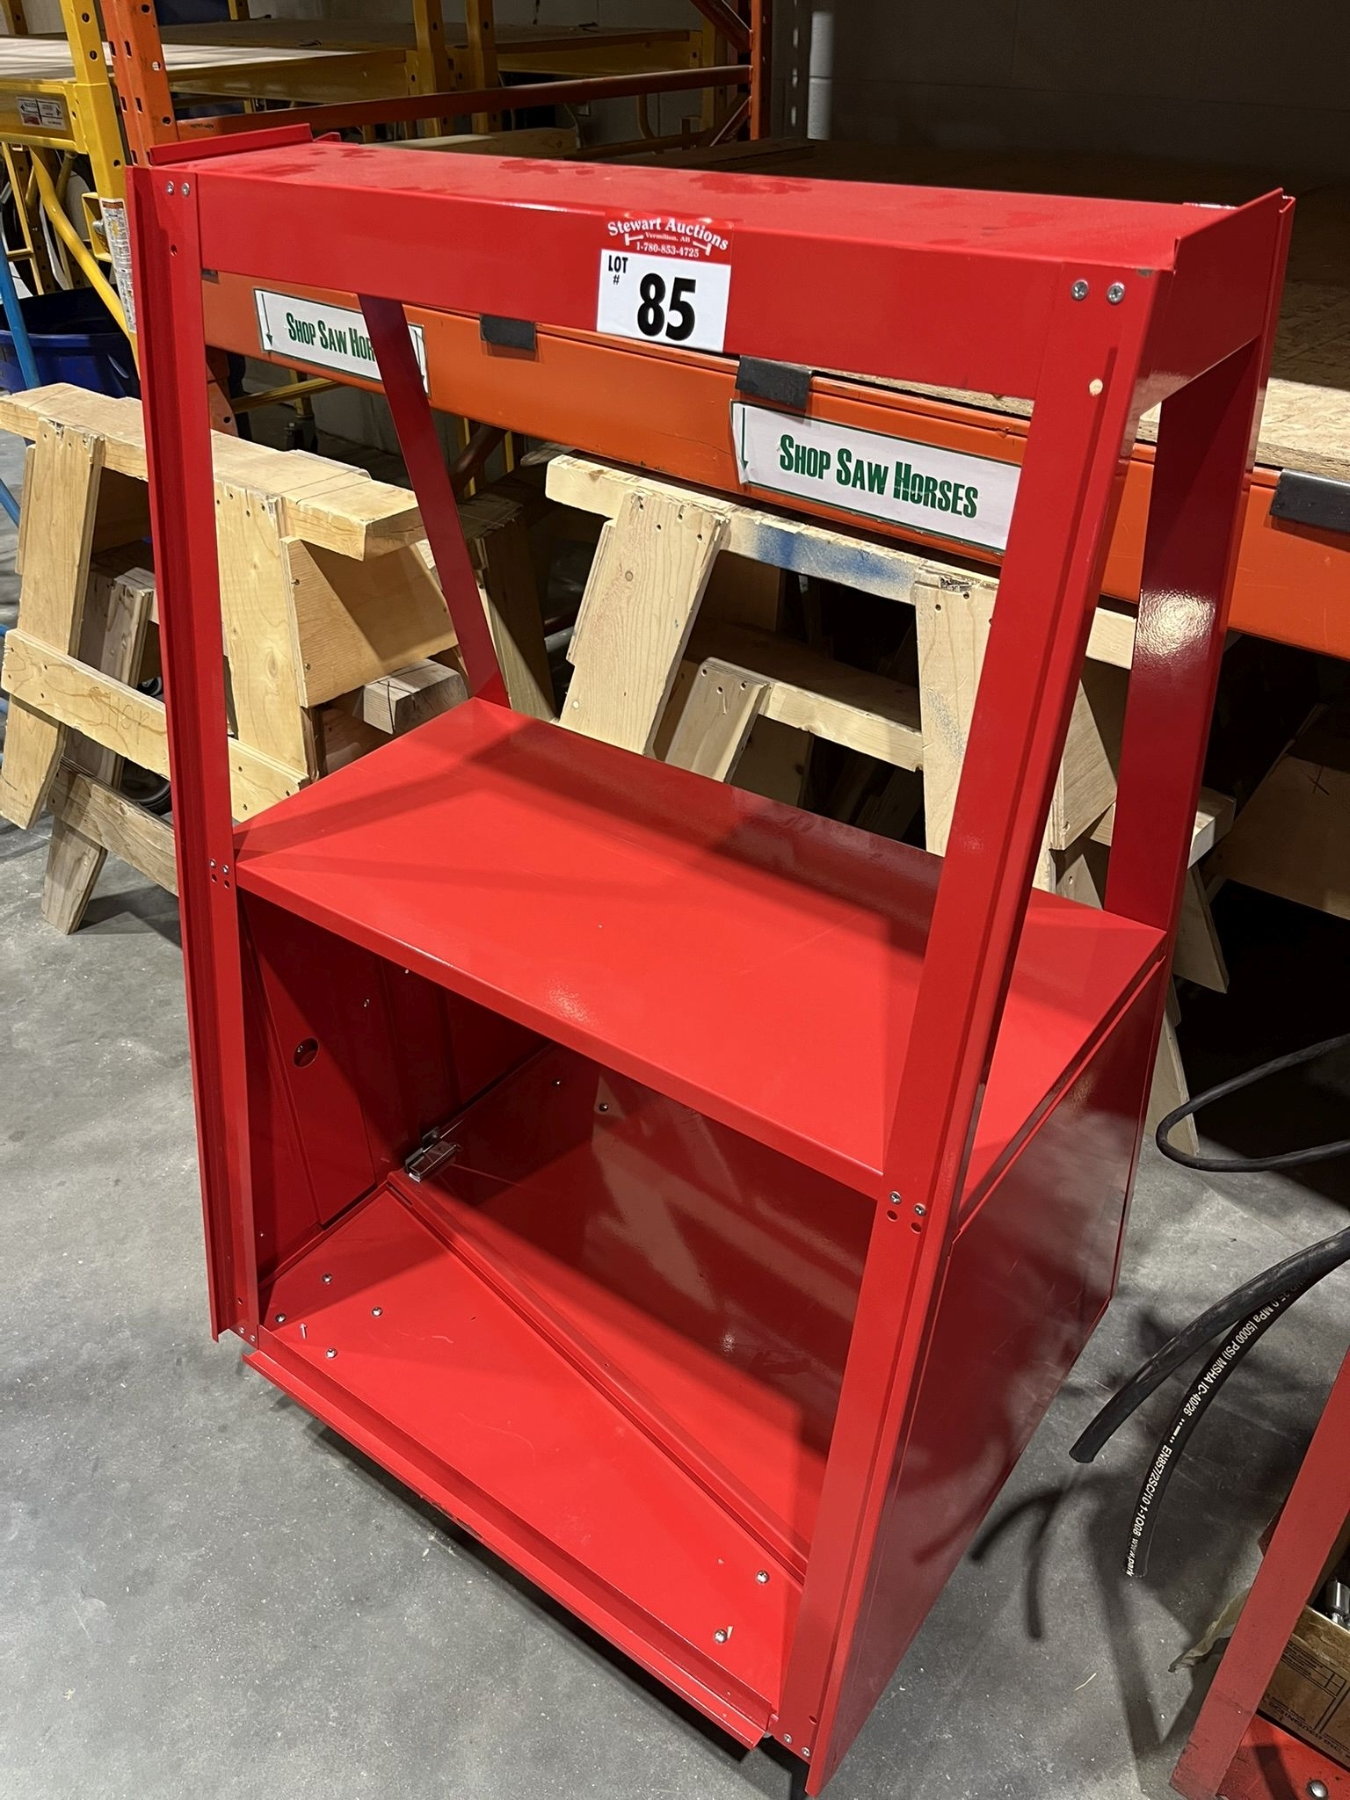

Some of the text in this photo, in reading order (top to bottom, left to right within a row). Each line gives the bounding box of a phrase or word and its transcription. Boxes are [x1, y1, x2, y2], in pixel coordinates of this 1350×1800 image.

[607, 217, 729, 251] Stewart Auctions
[636, 241, 700, 258] 1-780-853-4725
[608, 254, 628, 273] LOT
[612, 274, 620, 285] #
[637, 272, 696, 342] 85
[286, 313, 316, 345] SHOP
[317, 320, 347, 354] SAW
[779, 433, 979, 519] SHOP SAW HORSES
[1252, 1305, 1274, 1323] MPa
[1235, 1320, 1258, 1344] (5000
[1222, 1340, 1240, 1361] PSI)
[1203, 1357, 1227, 1384] MSHA
[1183, 1381, 1210, 1417] IC-40/26
[1142, 1444, 1173, 1505] EN857/2SC/10
